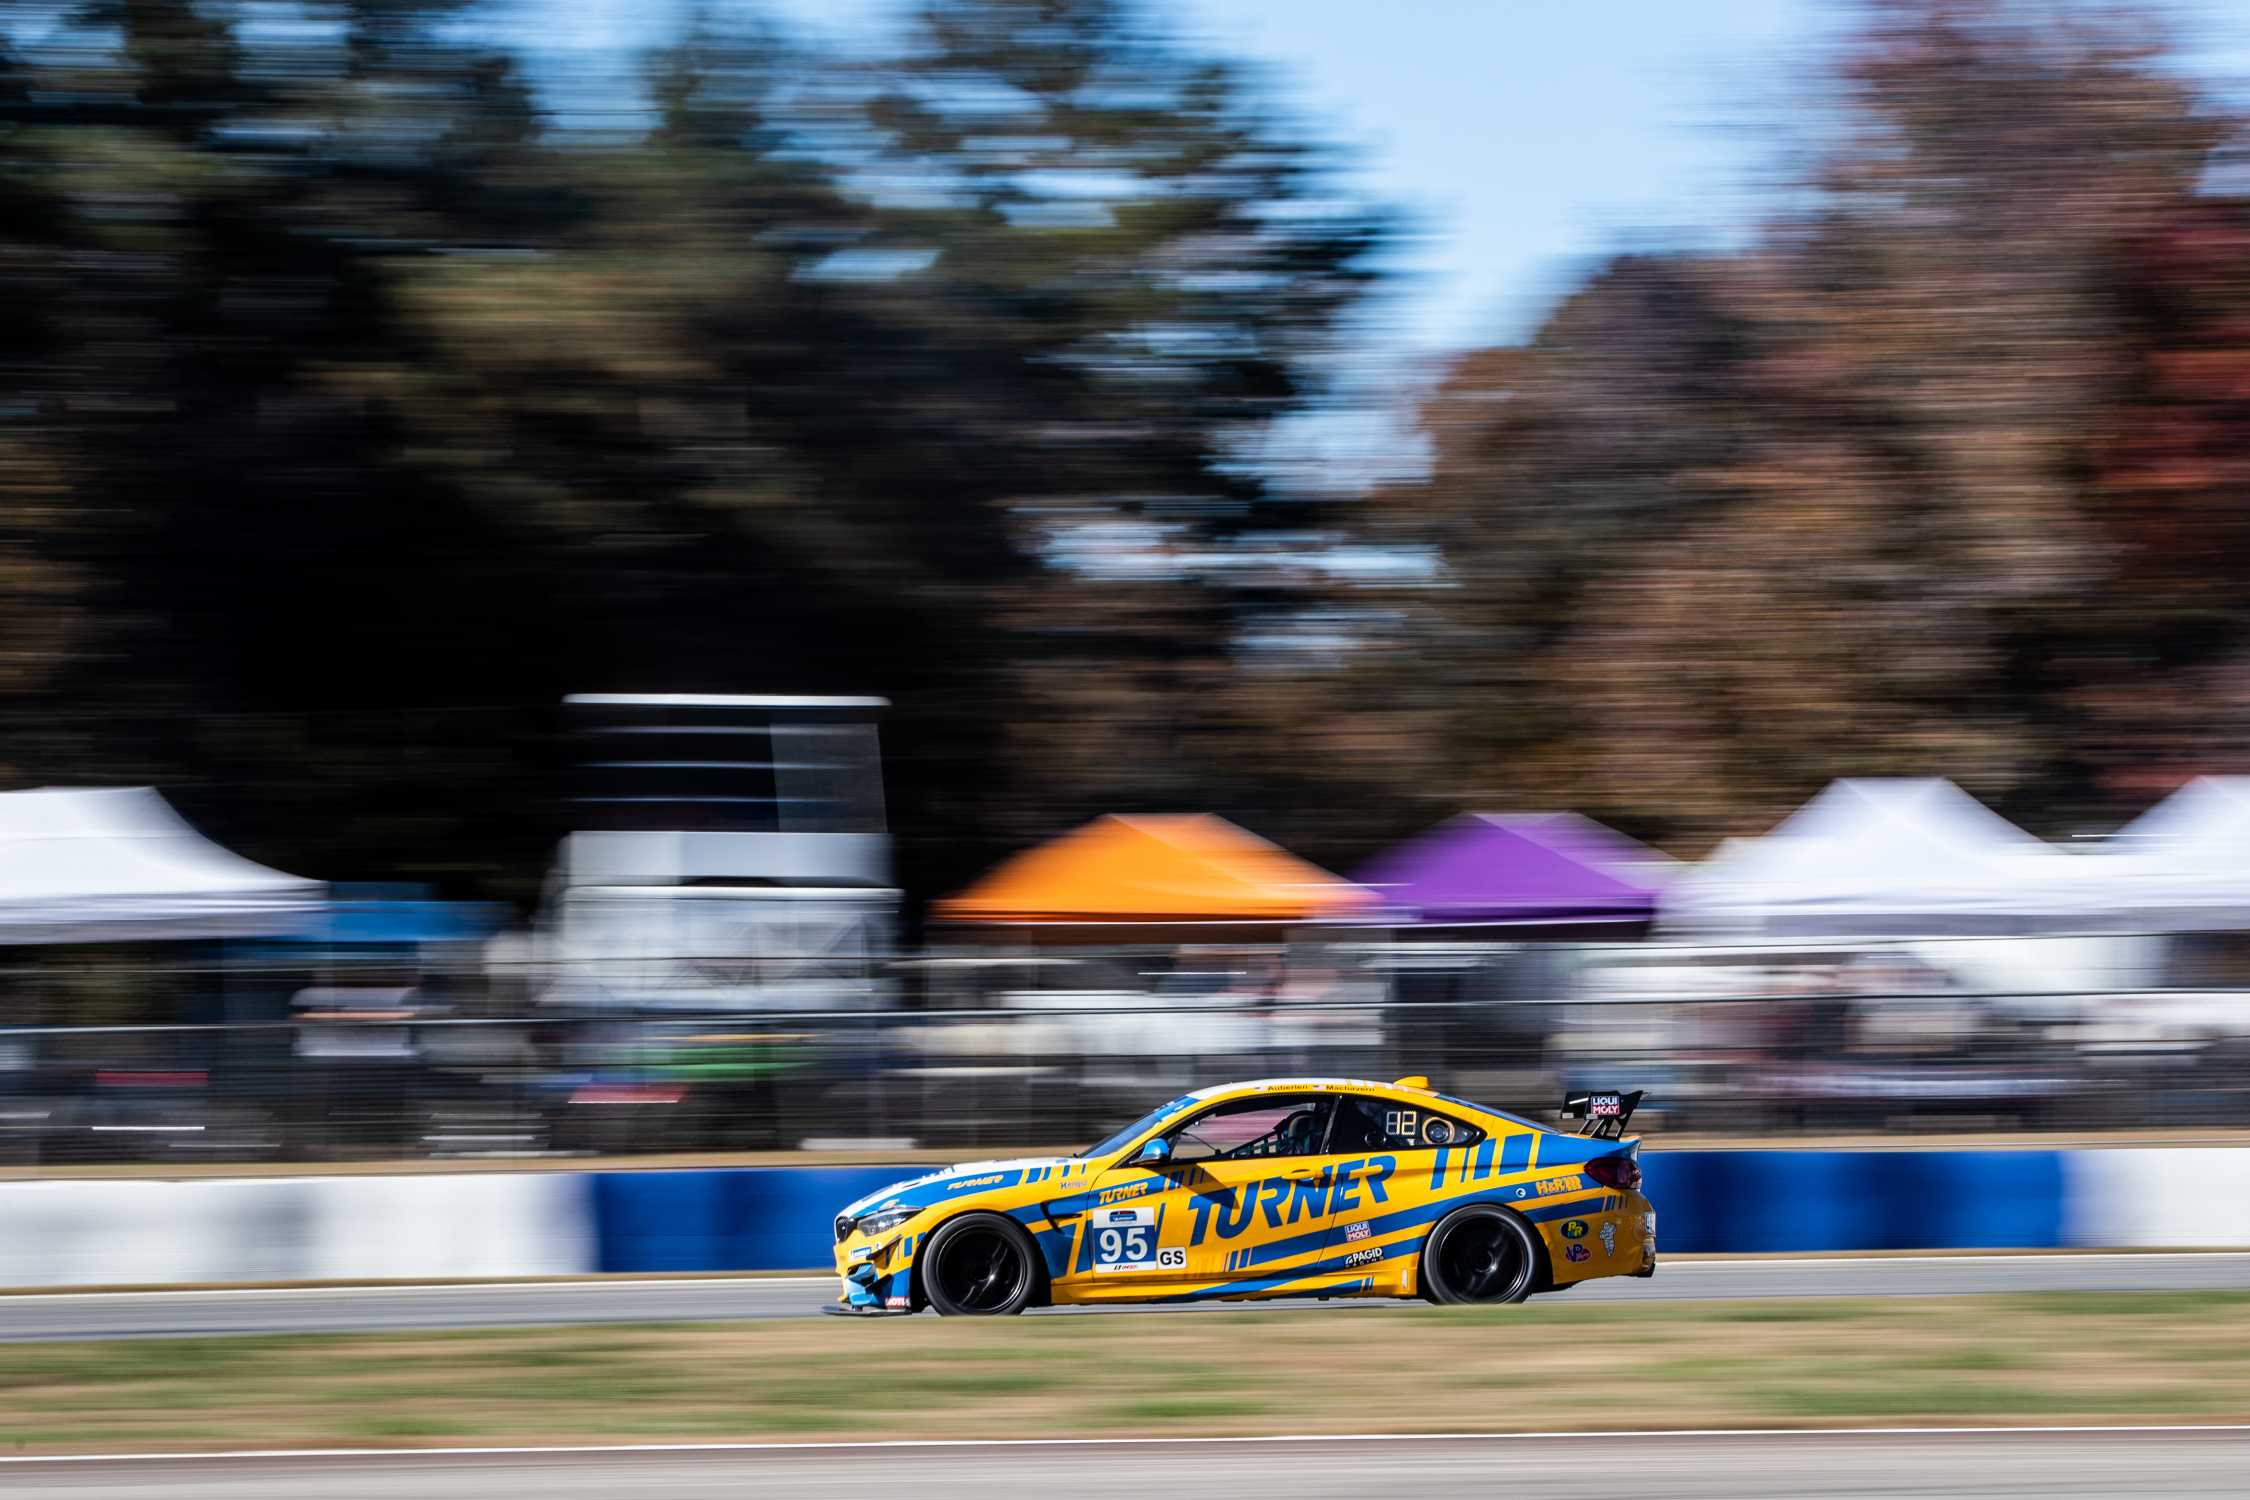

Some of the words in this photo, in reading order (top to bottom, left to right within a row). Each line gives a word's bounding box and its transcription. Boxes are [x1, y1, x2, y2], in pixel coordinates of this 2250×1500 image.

[1592, 1097, 1617, 1105] LIQUI
[1593, 1105, 1618, 1114] MOLY
[1099, 1182, 1148, 1204] TURNER
[1188, 1155, 1397, 1247] TURNER
[1346, 1222, 1368, 1233] LIQUI
[1348, 1230, 1369, 1240] MOLY
[1100, 1227, 1148, 1263] 95
[1160, 1250, 1184, 1265] GS
[1353, 1248, 1383, 1263] PAGID
